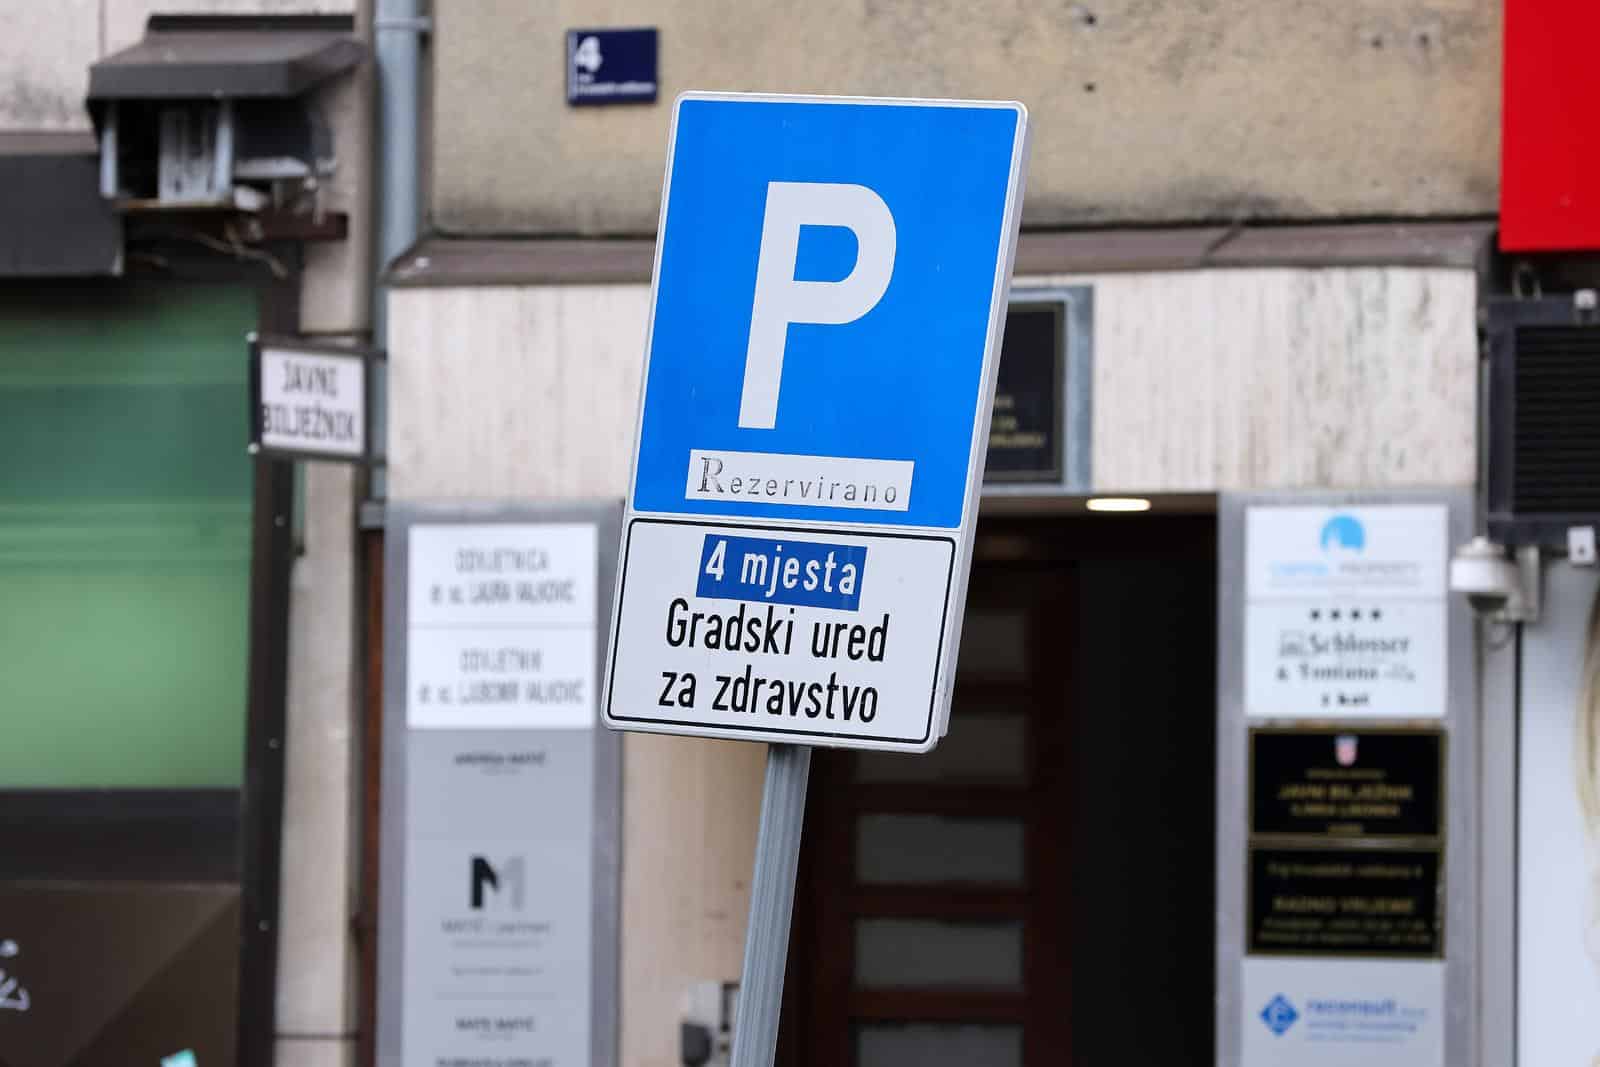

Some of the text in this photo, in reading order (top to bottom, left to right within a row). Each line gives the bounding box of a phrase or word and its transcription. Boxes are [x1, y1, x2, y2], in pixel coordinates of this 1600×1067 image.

[738, 182, 897, 429] P
[282, 360, 337, 398] JAVNI
[697, 456, 898, 505] Rezervirano
[705, 540, 857, 599] 4 mjesta
[666, 598, 890, 662] Gradski ured
[658, 664, 879, 724] za zdravstvo
